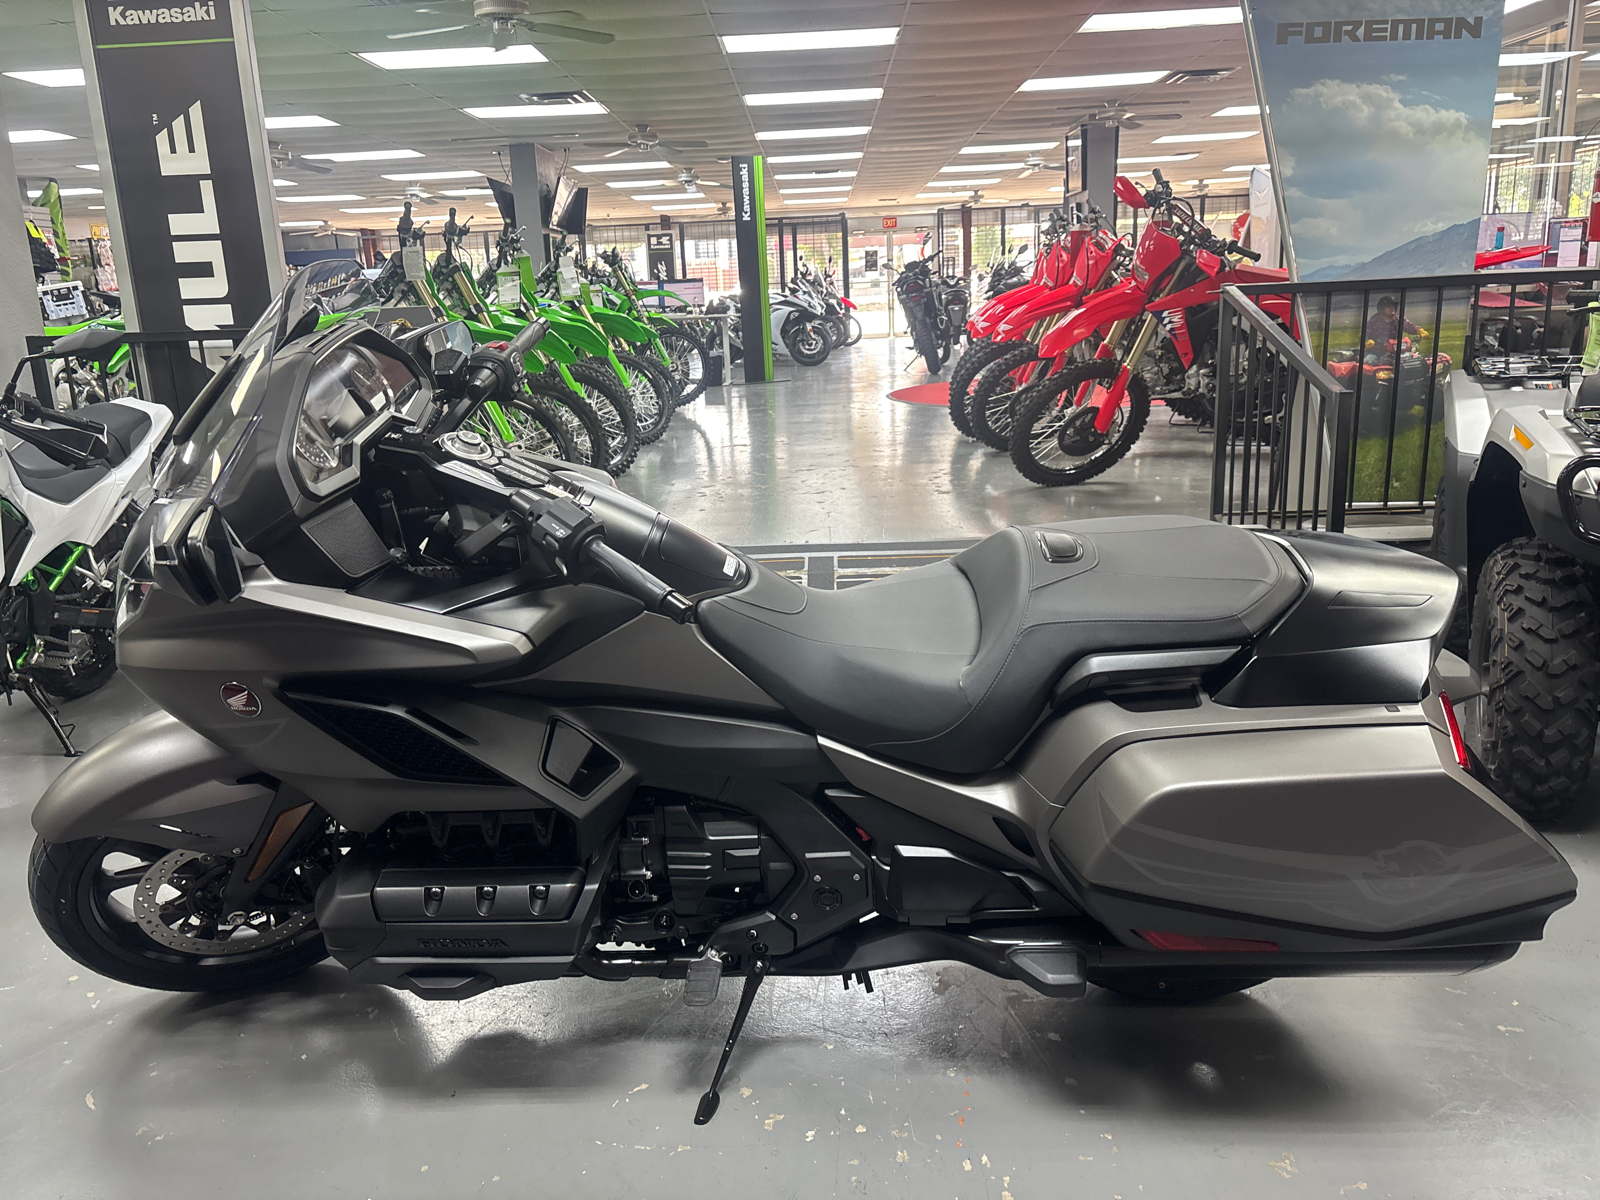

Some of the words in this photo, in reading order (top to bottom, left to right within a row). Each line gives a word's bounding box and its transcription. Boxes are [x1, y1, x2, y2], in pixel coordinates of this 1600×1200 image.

[107, 1, 216, 26] Kawasaki
[1276, 16, 1483, 45] FOREMAN
[739, 163, 751, 221] Kawasaki
[883, 218, 897, 228] EXIT
[418, 938, 509, 948] HONDA
